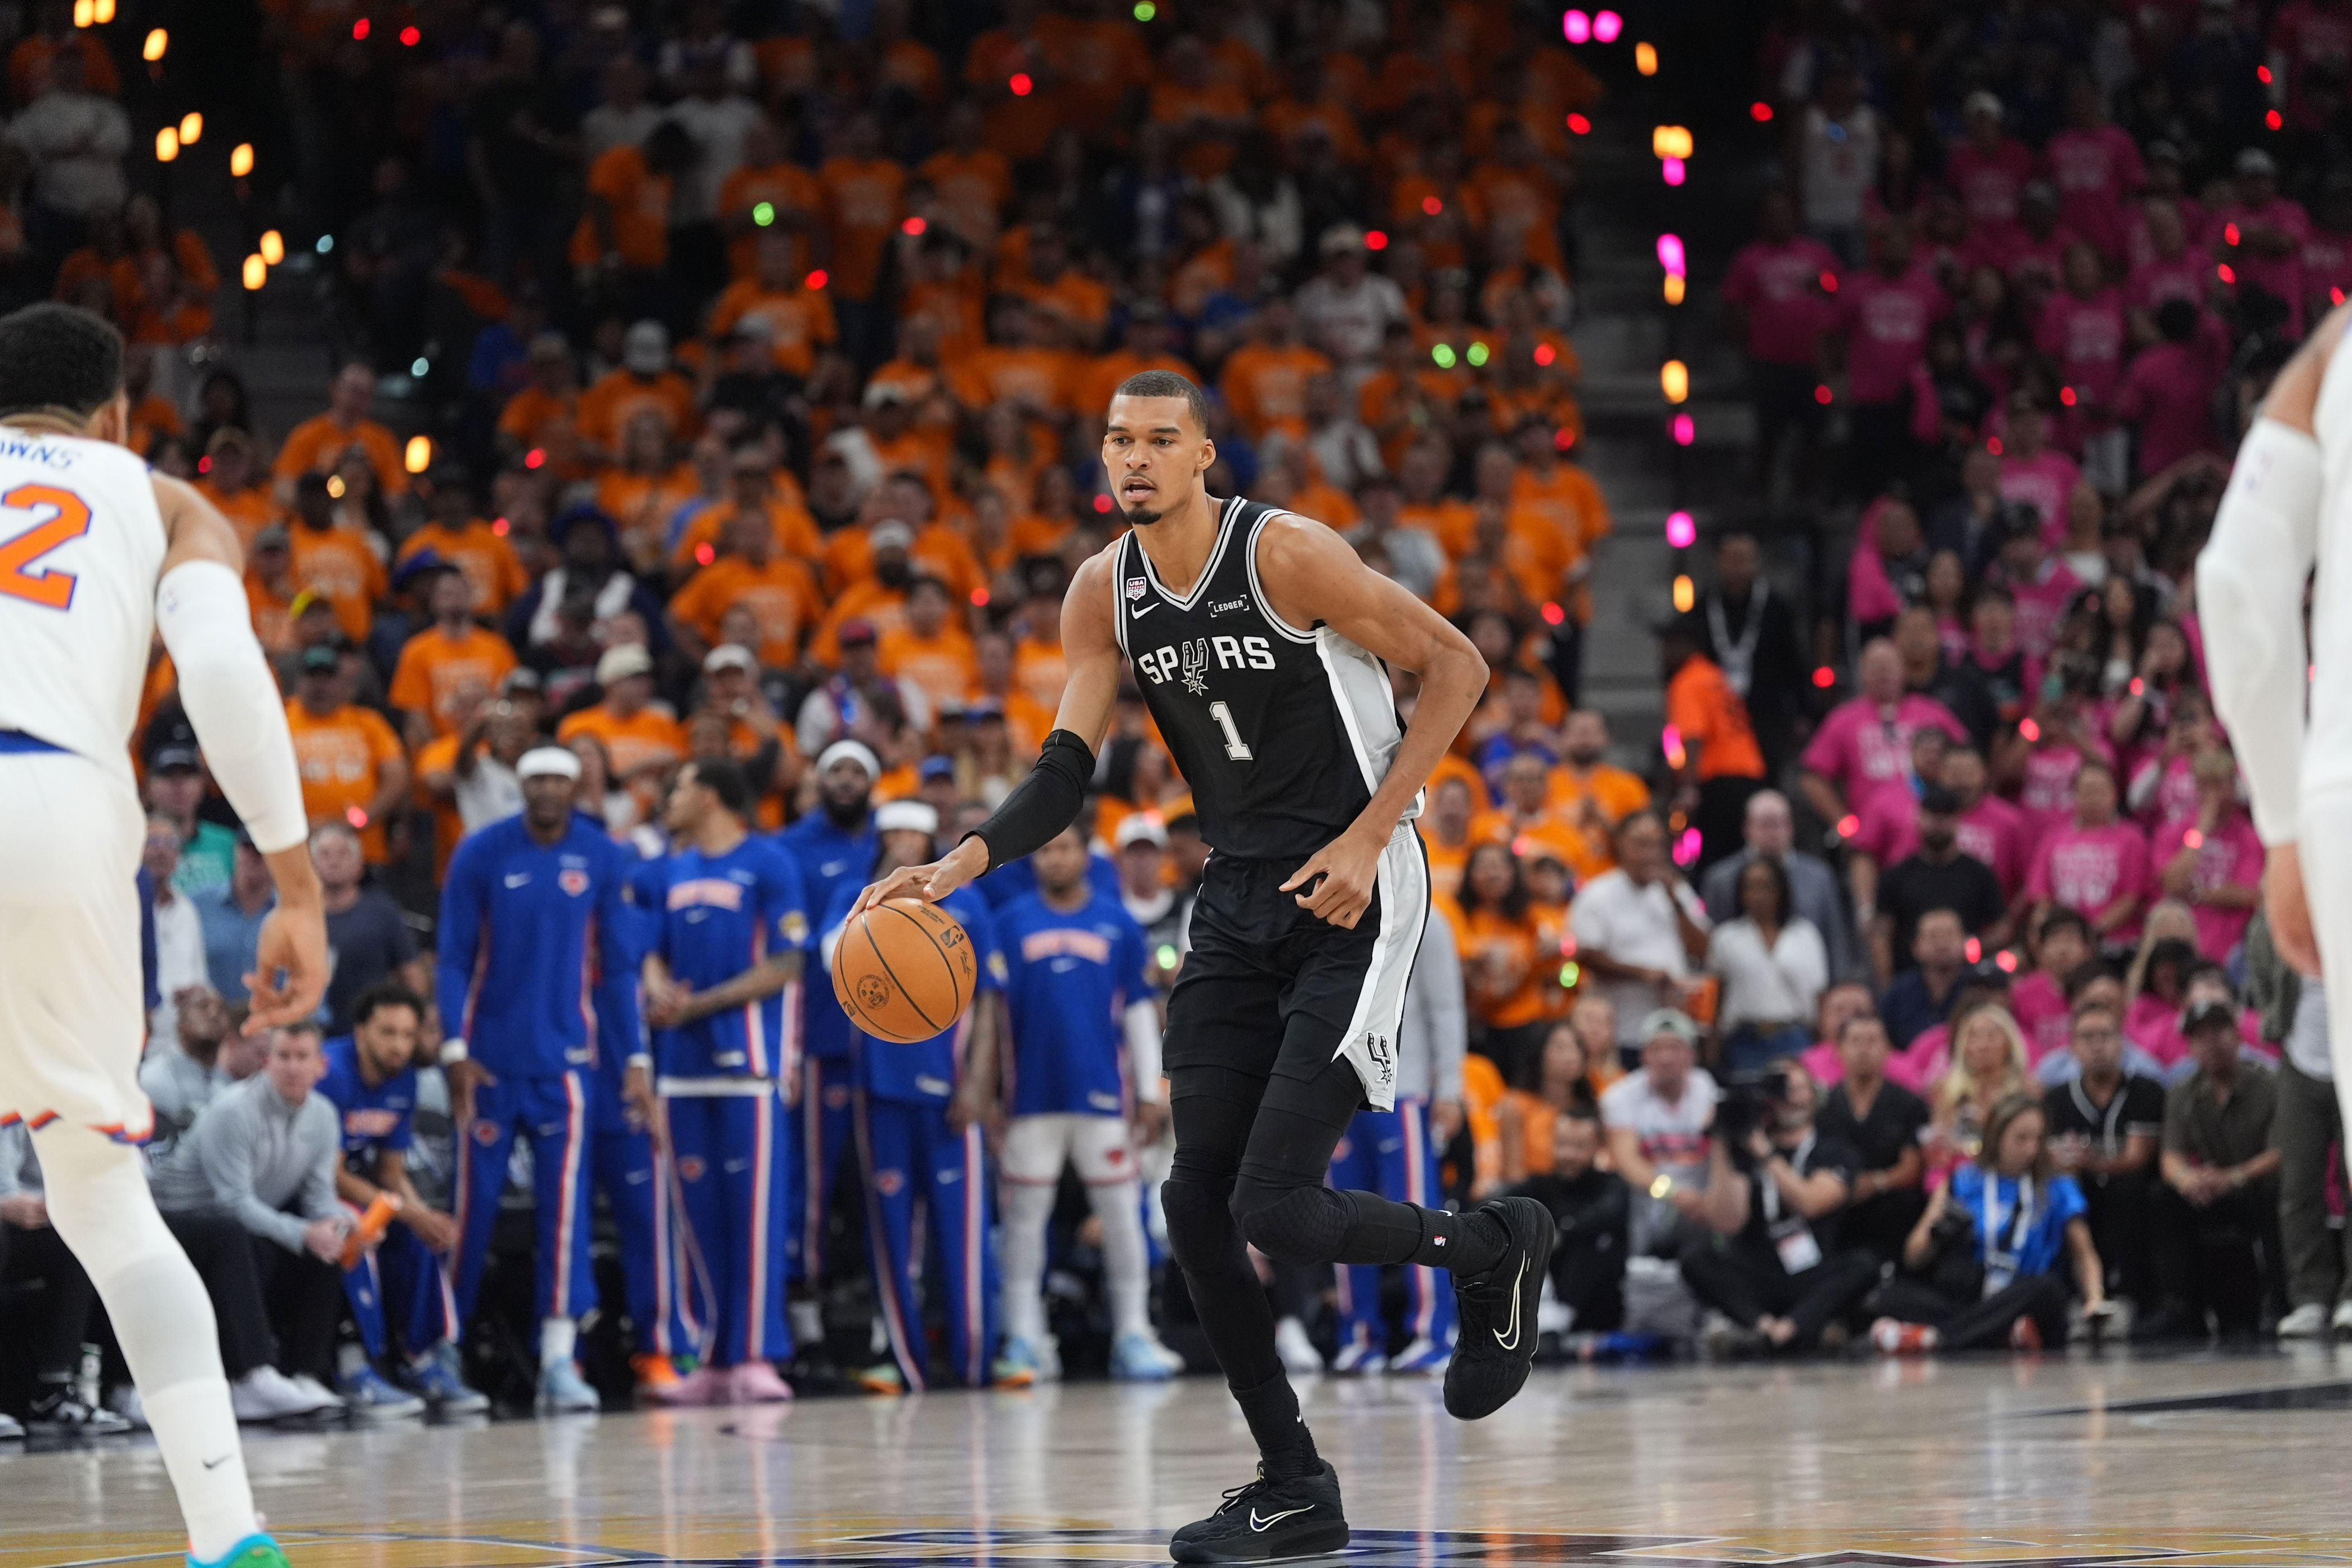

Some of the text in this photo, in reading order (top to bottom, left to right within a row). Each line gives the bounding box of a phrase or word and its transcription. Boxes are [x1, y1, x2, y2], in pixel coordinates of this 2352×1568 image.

[0, 481, 92, 612] 2
[1213, 599, 1244, 613] LEDGER
[1138, 636, 1276, 696] SPURS
[1209, 701, 1253, 761] 1
